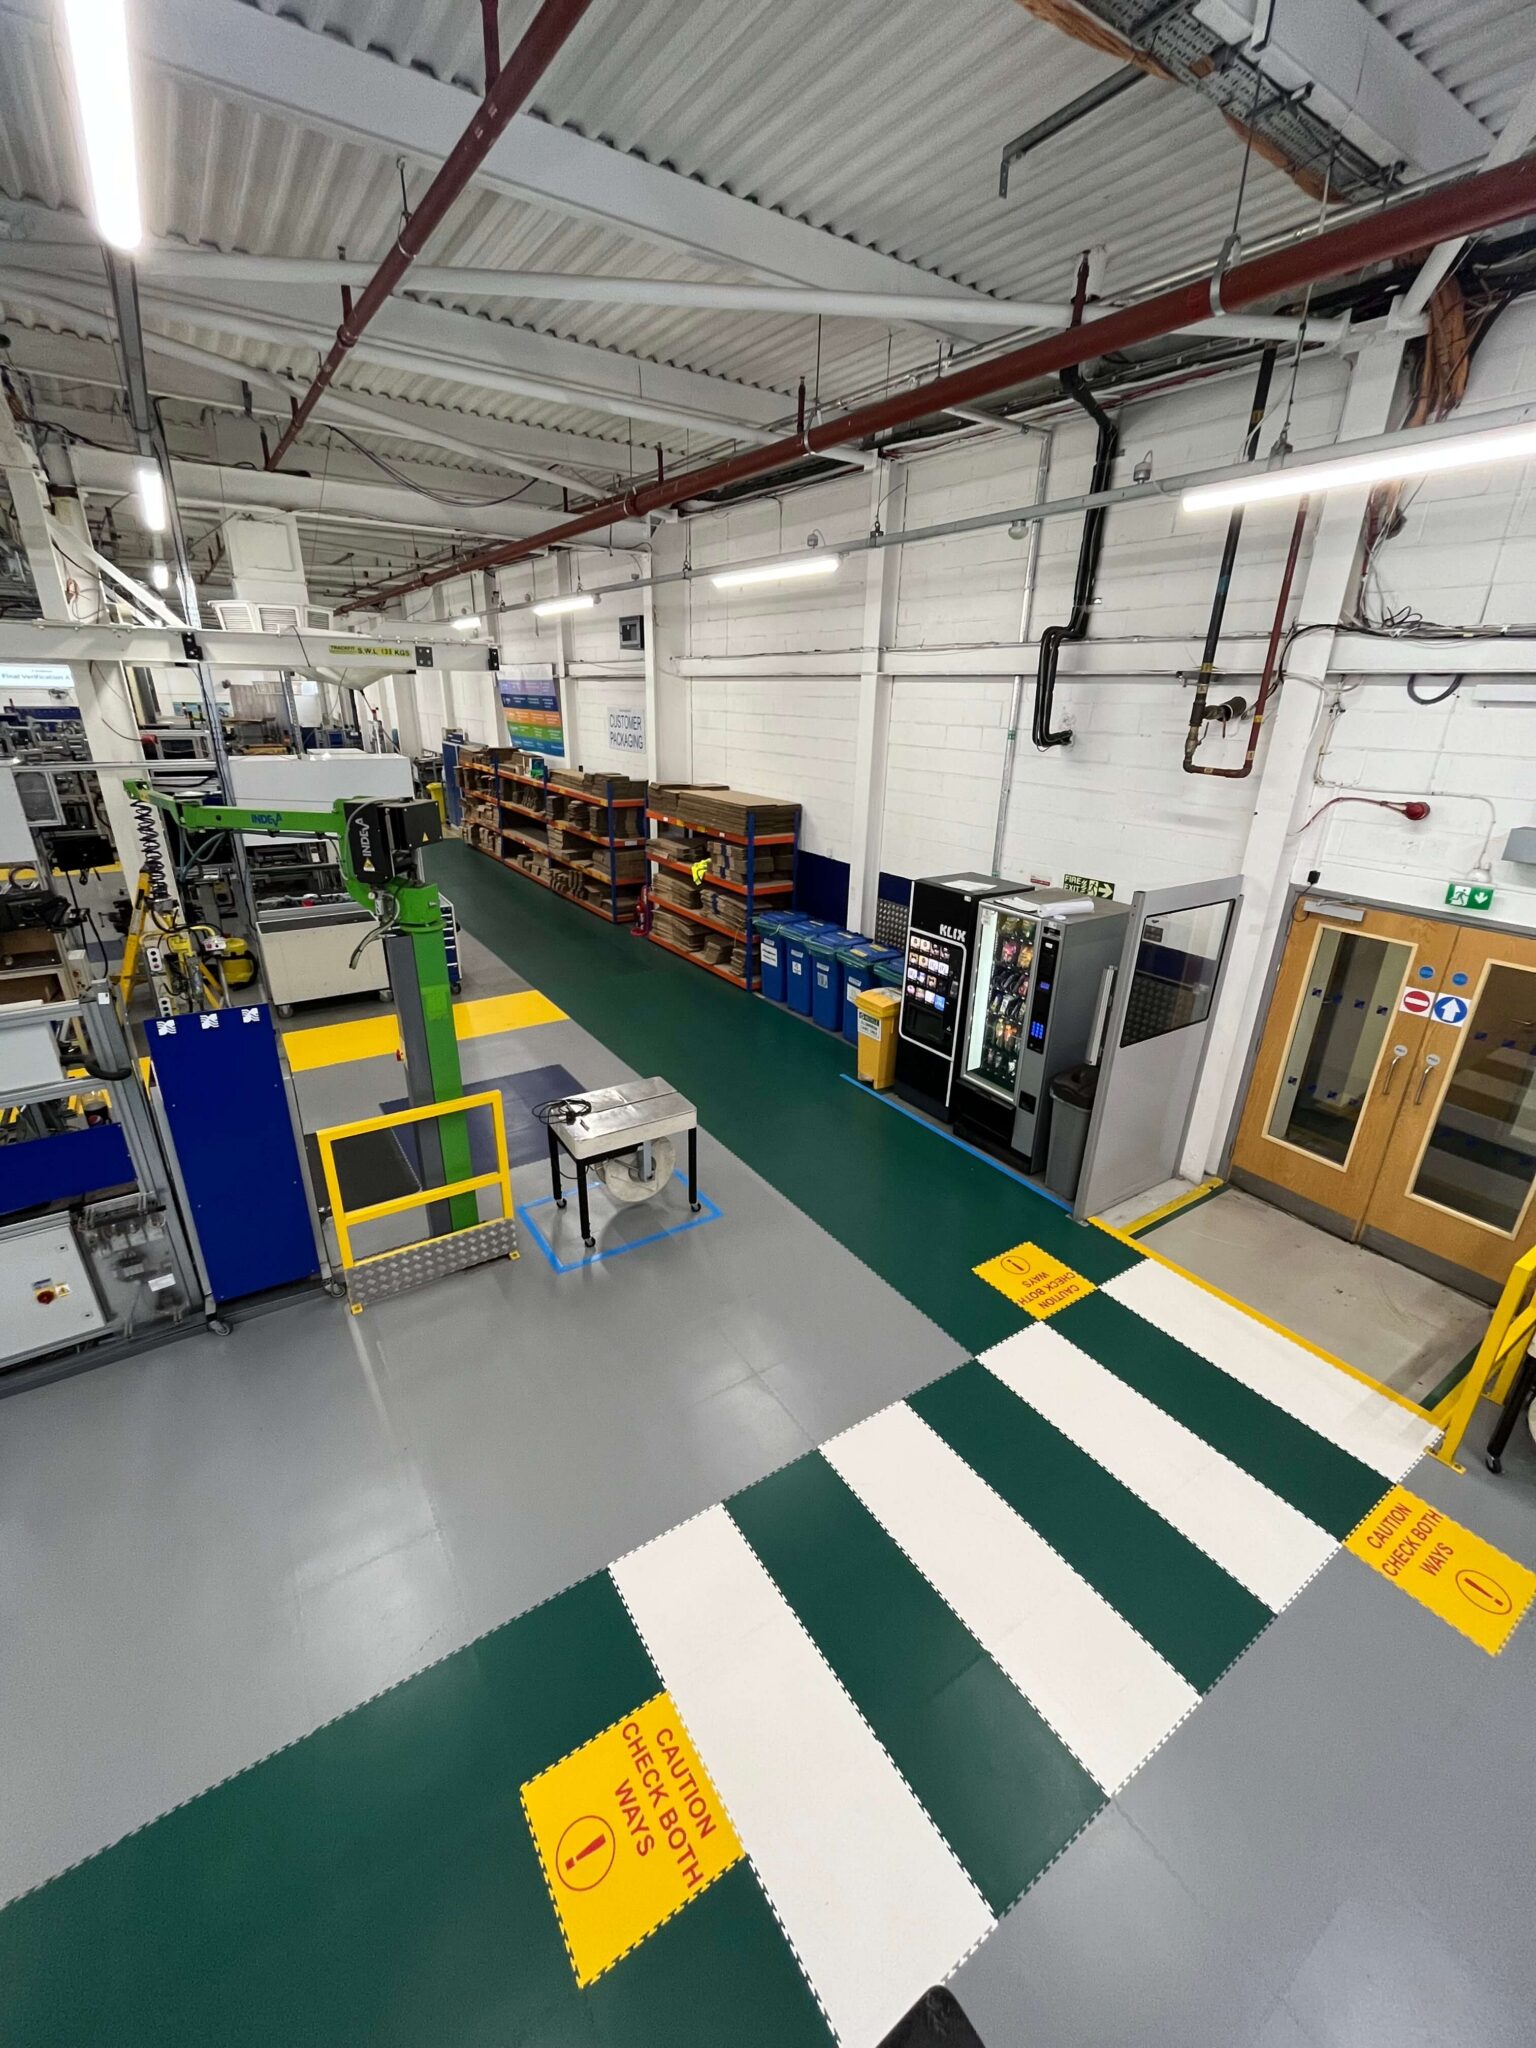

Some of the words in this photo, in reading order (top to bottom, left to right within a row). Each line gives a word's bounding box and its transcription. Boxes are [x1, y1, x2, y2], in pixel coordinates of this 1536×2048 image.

[610, 714, 642, 731] CUSTOMER
[610, 731, 643, 750] PACKAGING
[1064, 875, 1082, 885] FIRE
[1064, 884, 1080, 893] EXIT
[940, 923, 967, 943] KLIX
[1022, 1271, 1050, 1288] WAYS
[1043, 1271, 1076, 1292] CHECK
[1017, 1288, 1046, 1306] BOTH
[1038, 1284, 1080, 1309] CAUTION
[1366, 1502, 1412, 1549] CAUTION
[1381, 1535, 1422, 1577] CHECK
[1410, 1509, 1443, 1541] BOTH
[1420, 1542, 1454, 1577] WAYS
[656, 1728, 717, 1840] CAUTION
[622, 1722, 670, 1809] CHECK
[658, 1807, 704, 1888] BOTH
[614, 1778, 655, 1857] WAYS
